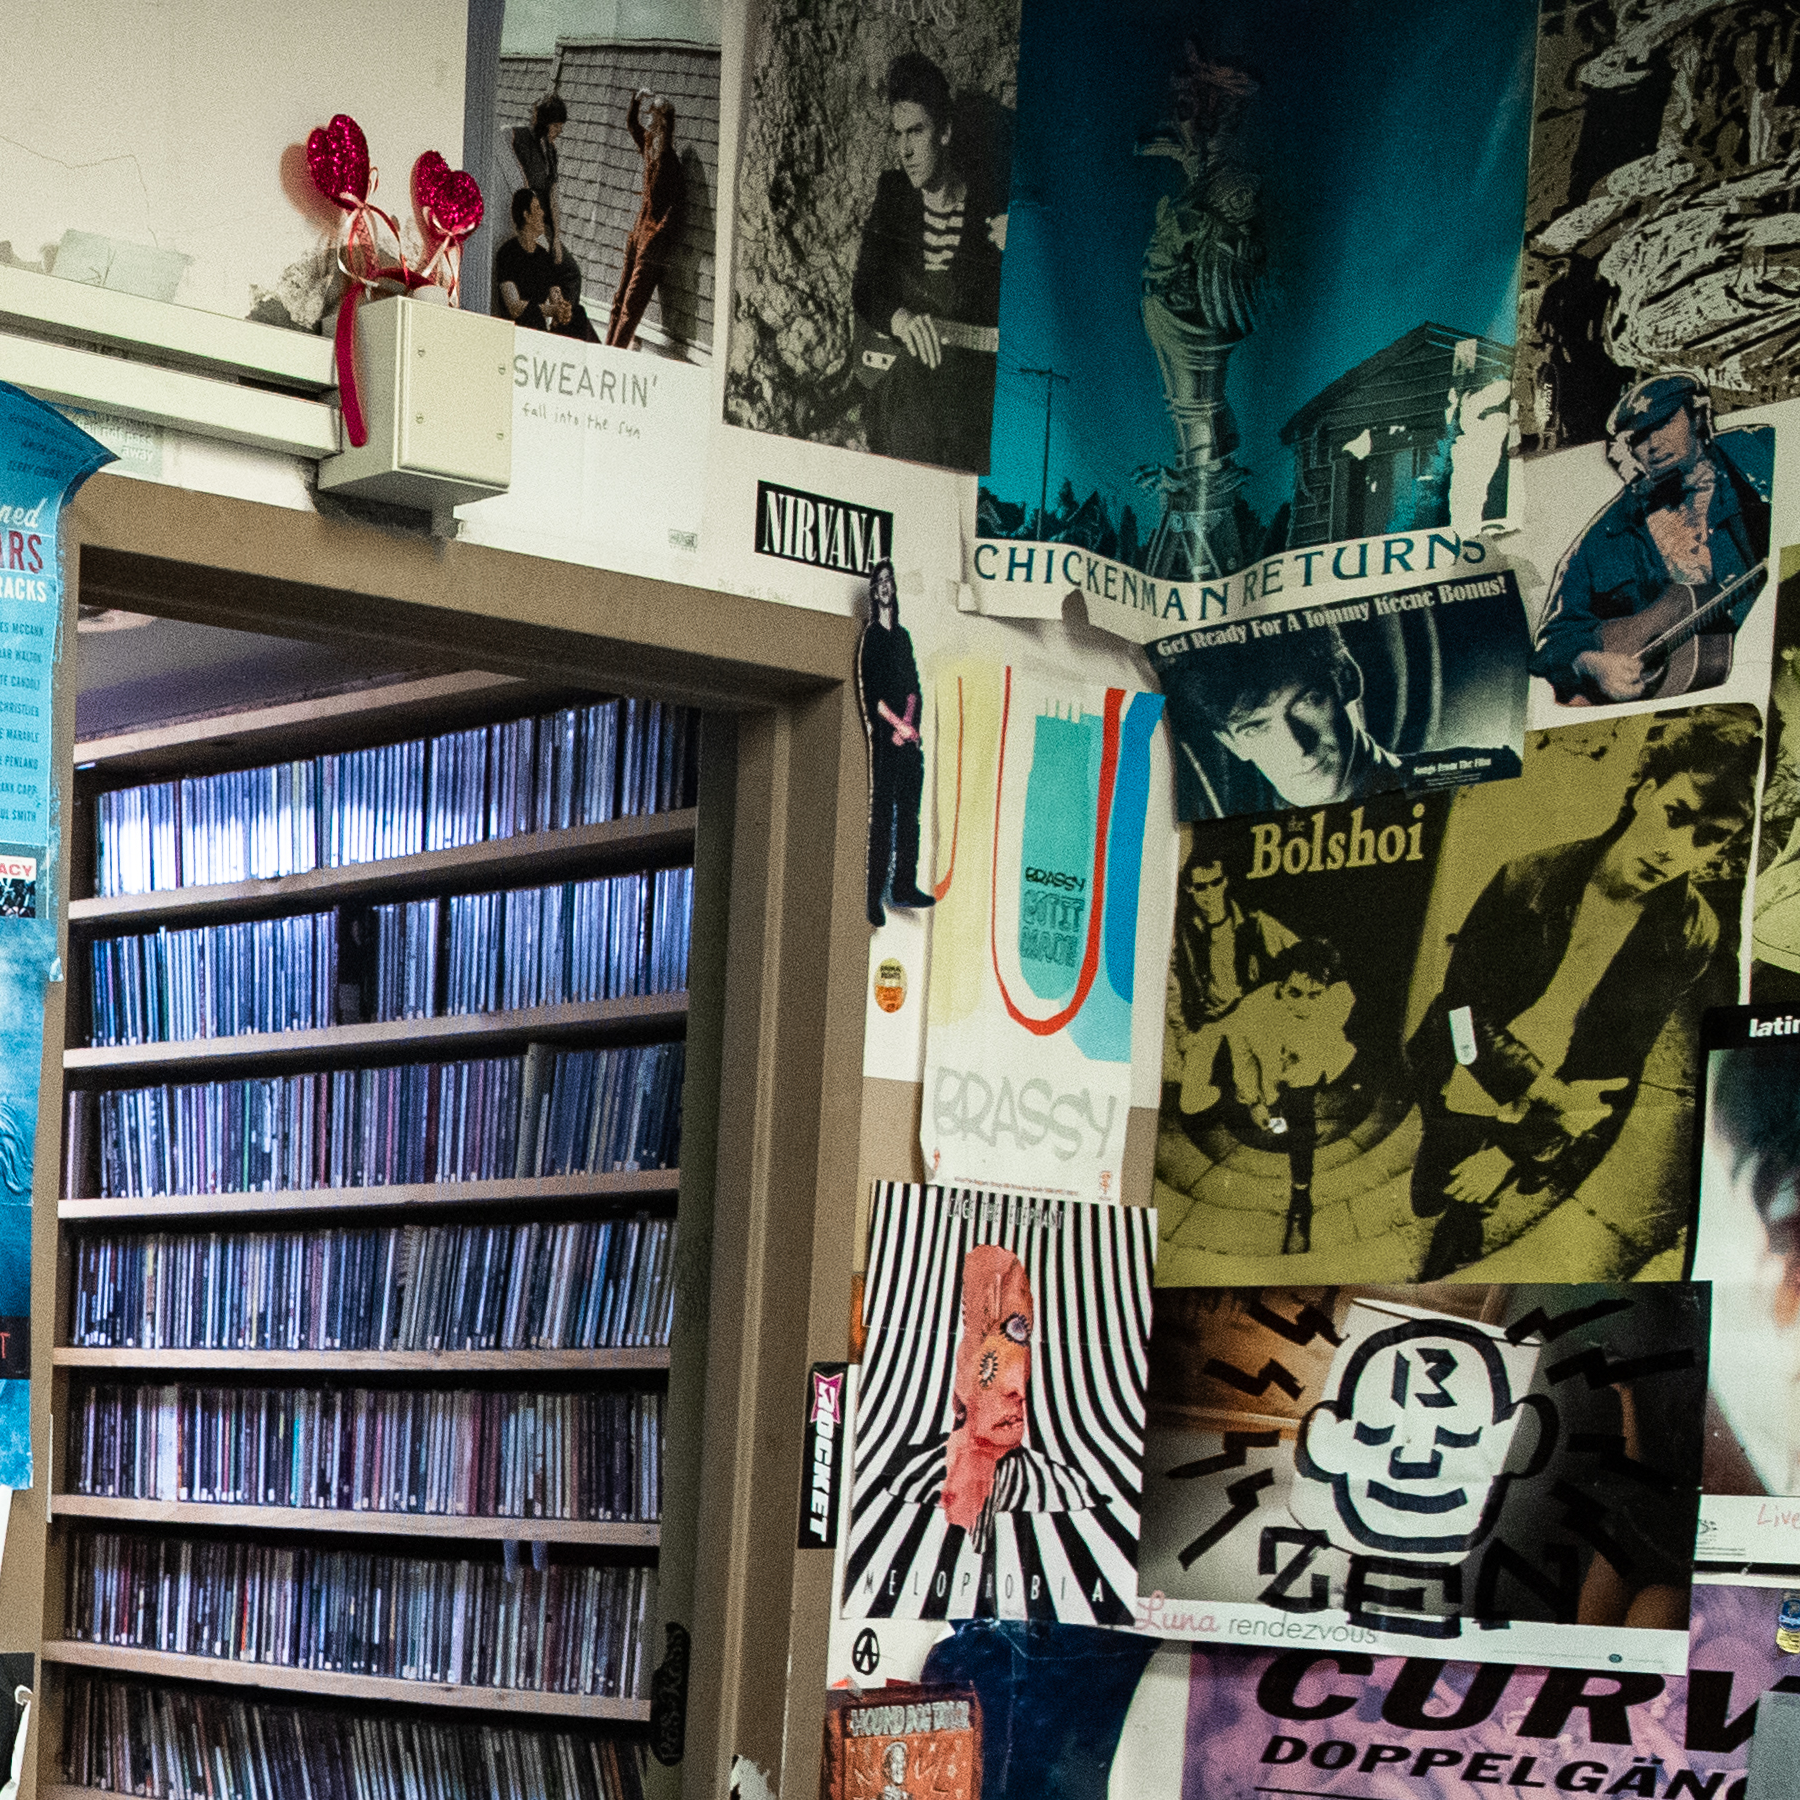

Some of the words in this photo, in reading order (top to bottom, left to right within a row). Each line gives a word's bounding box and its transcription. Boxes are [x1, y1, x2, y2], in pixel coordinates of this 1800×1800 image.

[513, 353, 659, 408] SWEARIN'
[521, 402, 548, 420] fall
[553, 407, 580, 430] into
[586, 412, 609, 432] the
[762, 490, 889, 575] NIRVANA
[974, 542, 1229, 623] CHICKENMAN
[1240, 532, 1488, 608] RETURNS
[1157, 636, 1192, 659] Get
[1194, 624, 1248, 654] Ready
[1250, 617, 1285, 639] For
[1286, 613, 1303, 631] A
[1303, 598, 1370, 628] Tommy
[1436, 570, 1508, 609] Bonus!
[1026, 867, 1086, 892] BRASSY
[1246, 802, 1425, 882] Bolshoi
[933, 1066, 1117, 1161] BRASSY
[1135, 1590, 1220, 1635] Luna
[1228, 1615, 1379, 1647] rendezvous
